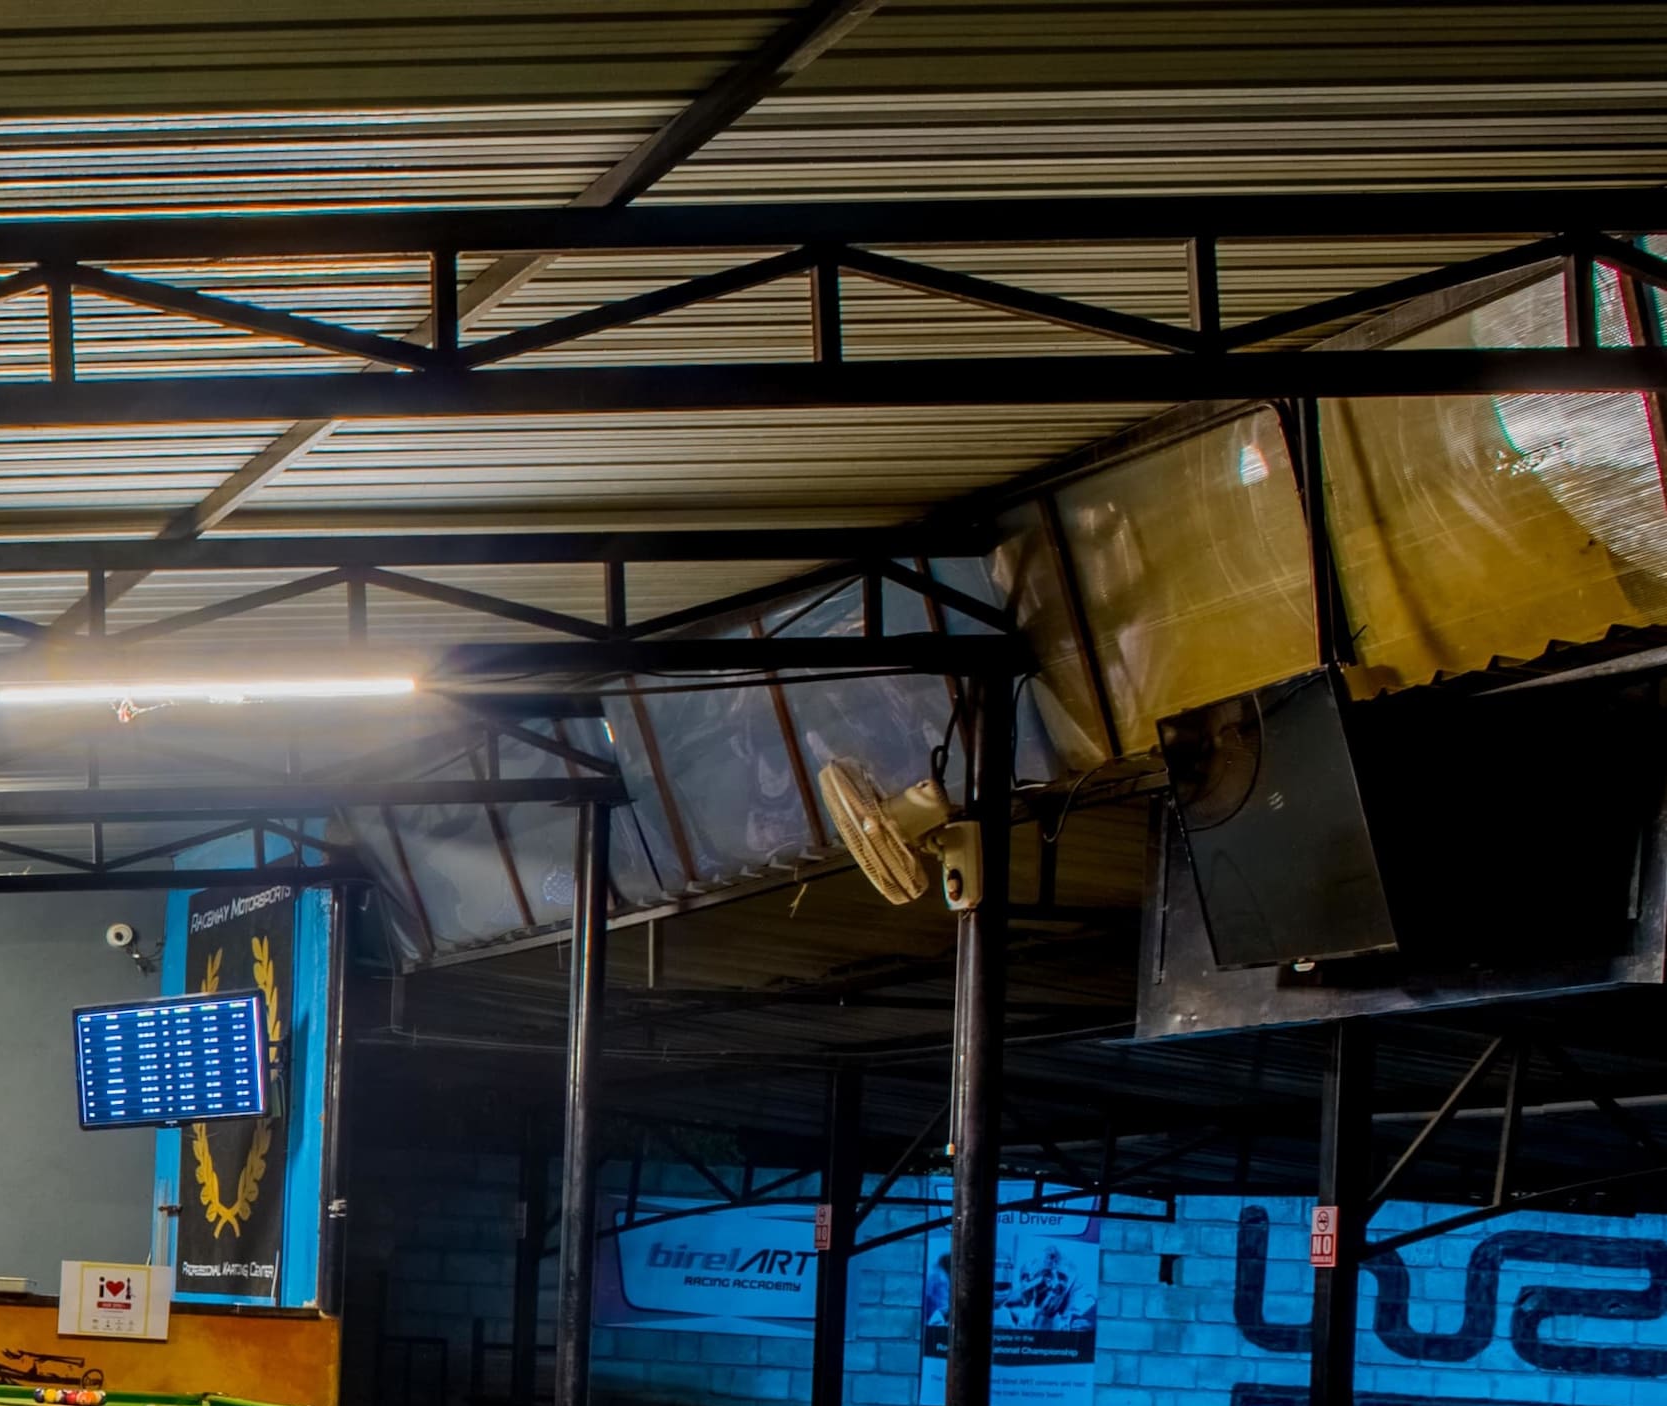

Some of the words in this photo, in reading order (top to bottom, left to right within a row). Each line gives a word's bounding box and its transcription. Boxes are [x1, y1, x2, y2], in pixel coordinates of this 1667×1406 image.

[1019, 1212, 1064, 1225] Driver
[1312, 1235, 1332, 1255] NO
[684, 1276, 730, 1288] RACING
[733, 1278, 801, 1292] ACCADEMY
[1021, 1346, 1078, 1358] Championship
